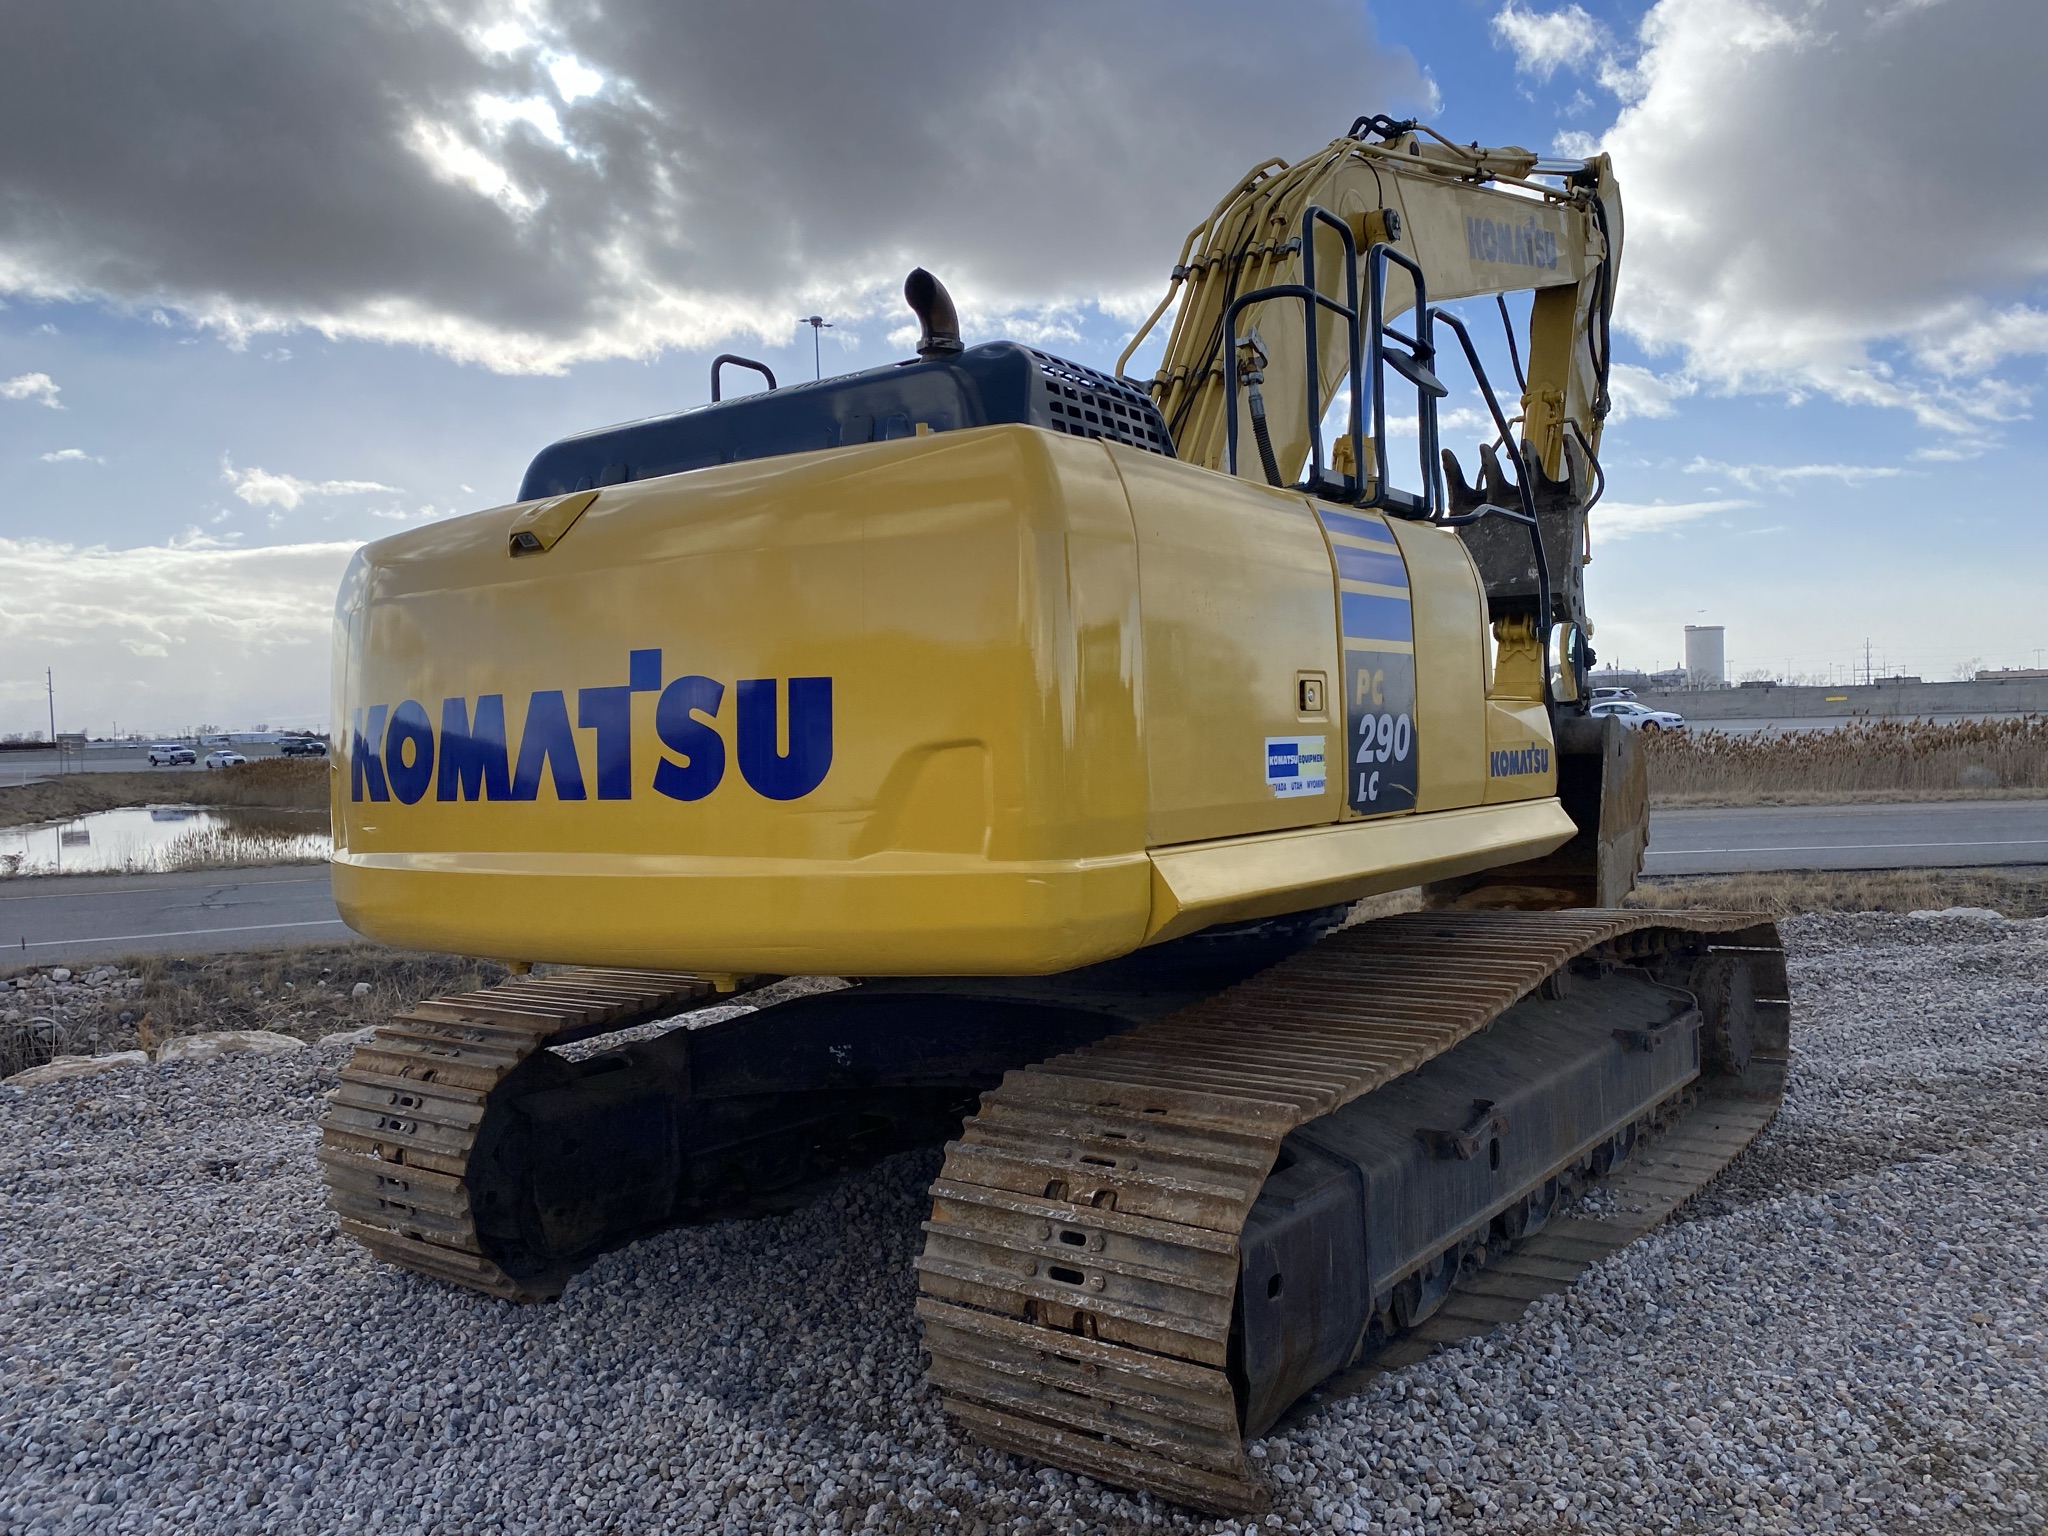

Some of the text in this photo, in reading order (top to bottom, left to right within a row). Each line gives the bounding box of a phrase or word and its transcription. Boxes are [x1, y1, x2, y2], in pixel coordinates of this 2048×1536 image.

[1466, 215, 1557, 271] KOMATSU
[1356, 669, 1384, 705] PC
[352, 648, 833, 805] KOMATSU
[1356, 713, 1411, 763] 290
[1269, 755, 1298, 765] KOMATSU
[1490, 742, 1549, 777] KOMATSU
[1291, 781, 1302, 790] UTAH
[1356, 770, 1379, 802] LC
